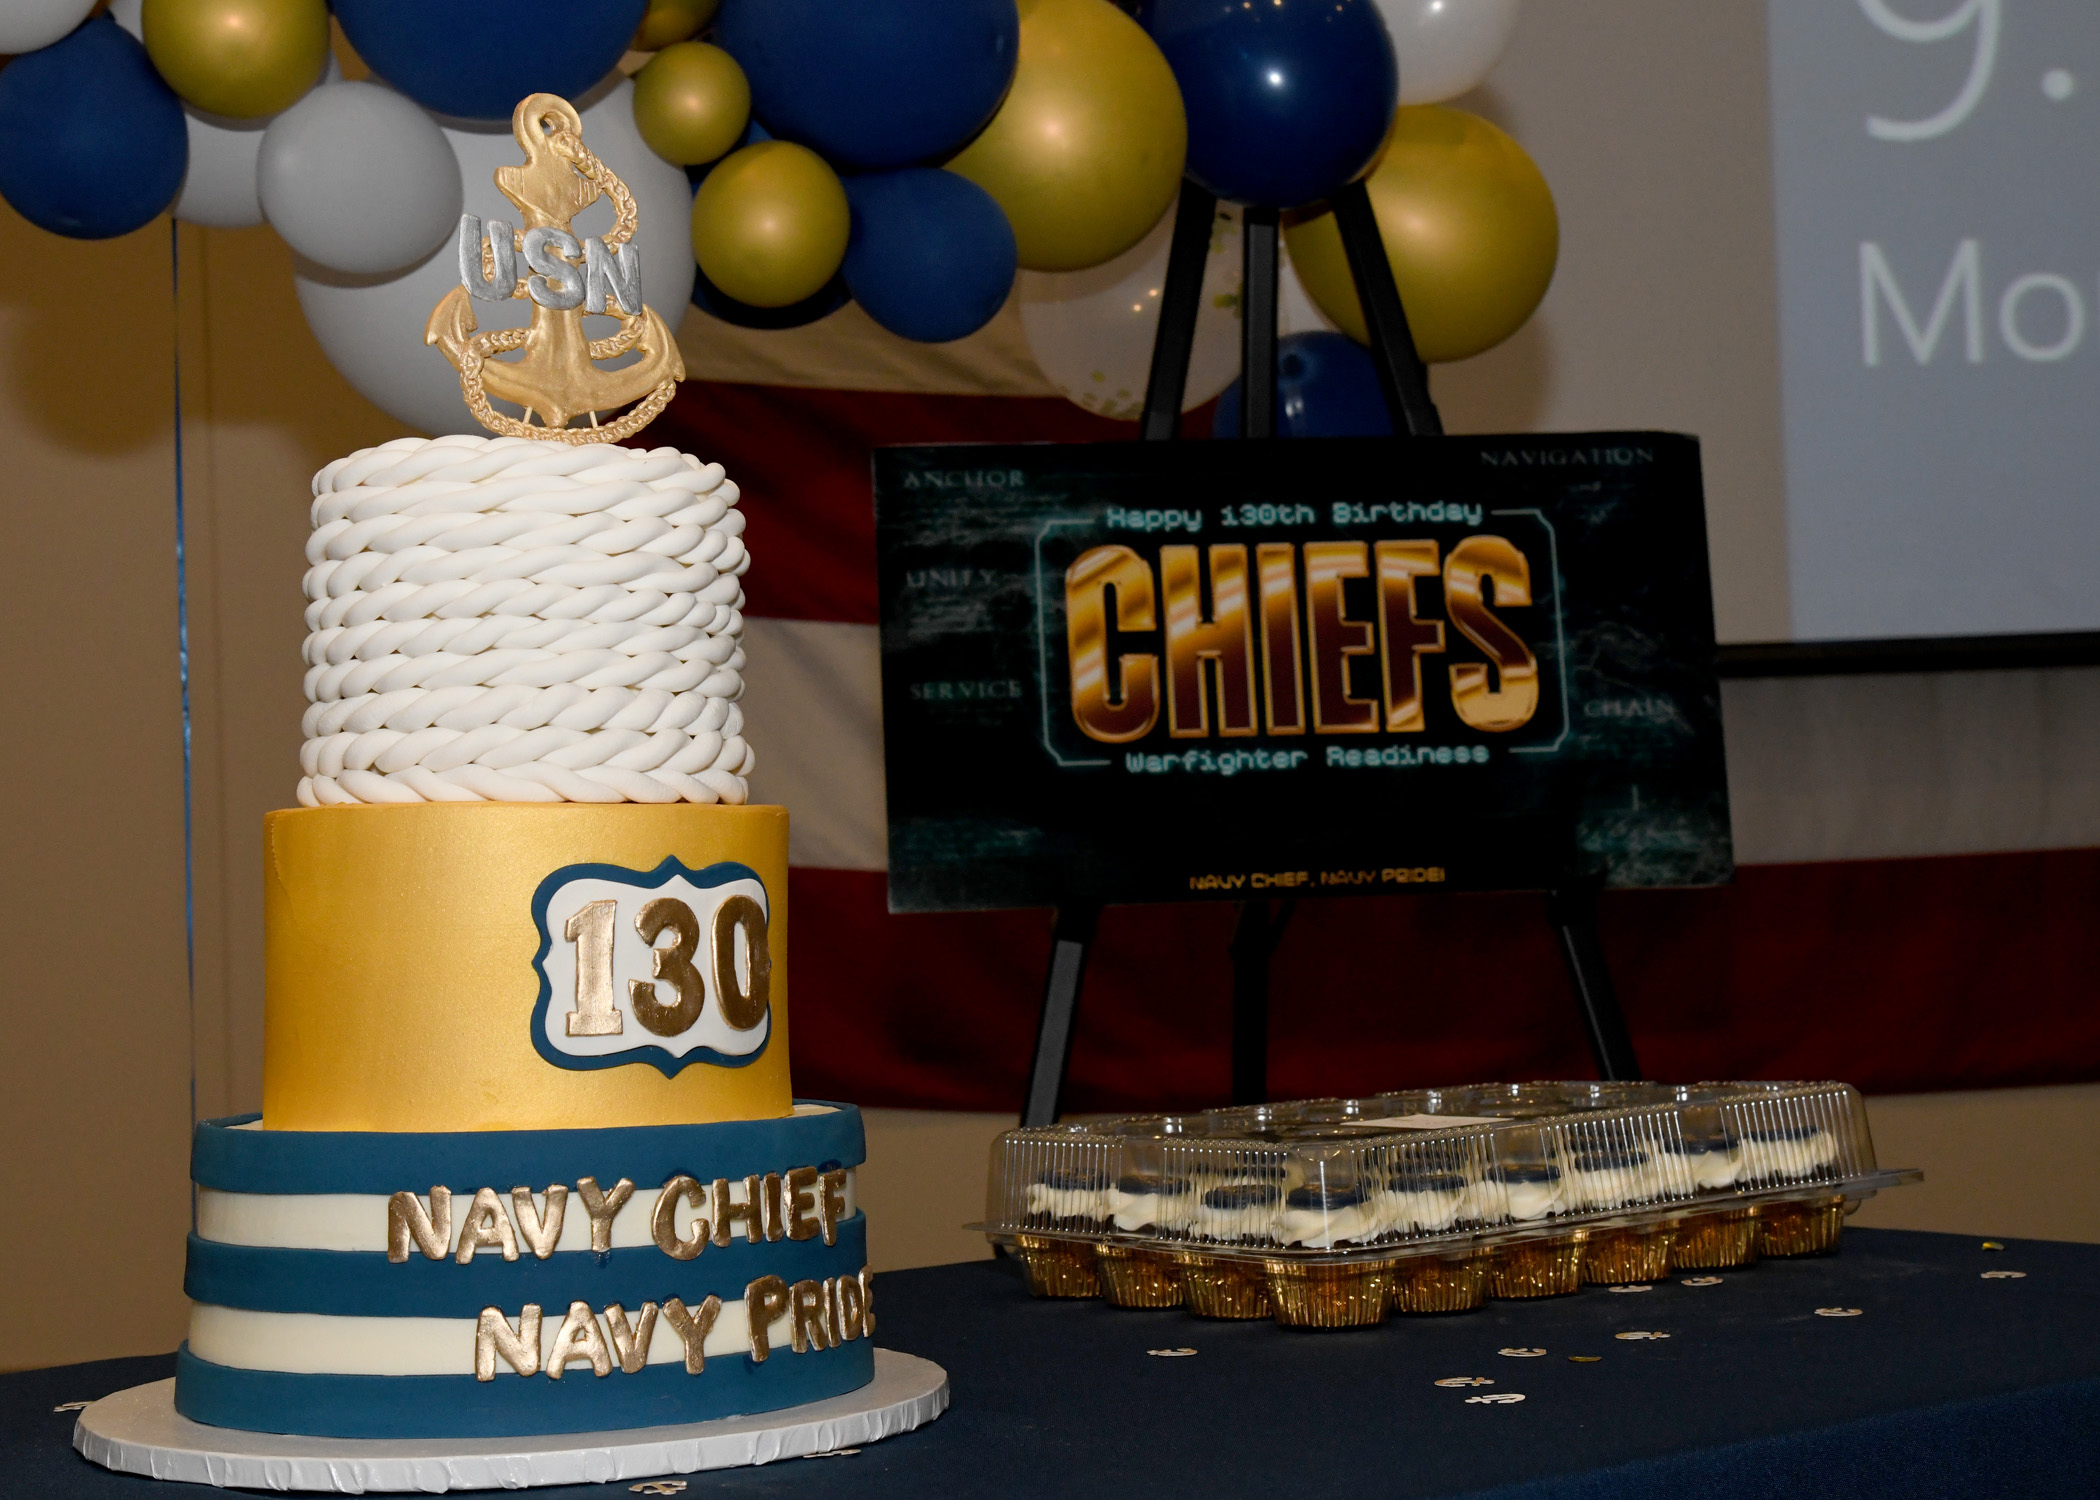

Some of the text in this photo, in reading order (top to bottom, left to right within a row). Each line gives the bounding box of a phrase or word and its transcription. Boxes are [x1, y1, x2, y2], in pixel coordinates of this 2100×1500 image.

[459, 213, 642, 316] USN
[1859, 239, 2100, 366] Mo
[1480, 447, 1655, 466] NAVIGATION
[904, 468, 1024, 488] ANCHOR
[1106, 500, 1482, 532] Happy 130th Birthday
[906, 568, 997, 588] UNITY
[1064, 534, 1539, 743] CHIEFS
[909, 680, 1023, 700] SERVICE
[1583, 699, 1676, 719] CHAIN
[1125, 744, 1490, 776] Warfighter Readiness
[1189, 874, 1247, 890] NAVY
[1320, 869, 1377, 886] NAVY
[564, 895, 771, 1038] 130
[387, 1166, 848, 1264] NAVY CHIEF
[475, 1293, 722, 1383] NAVY
